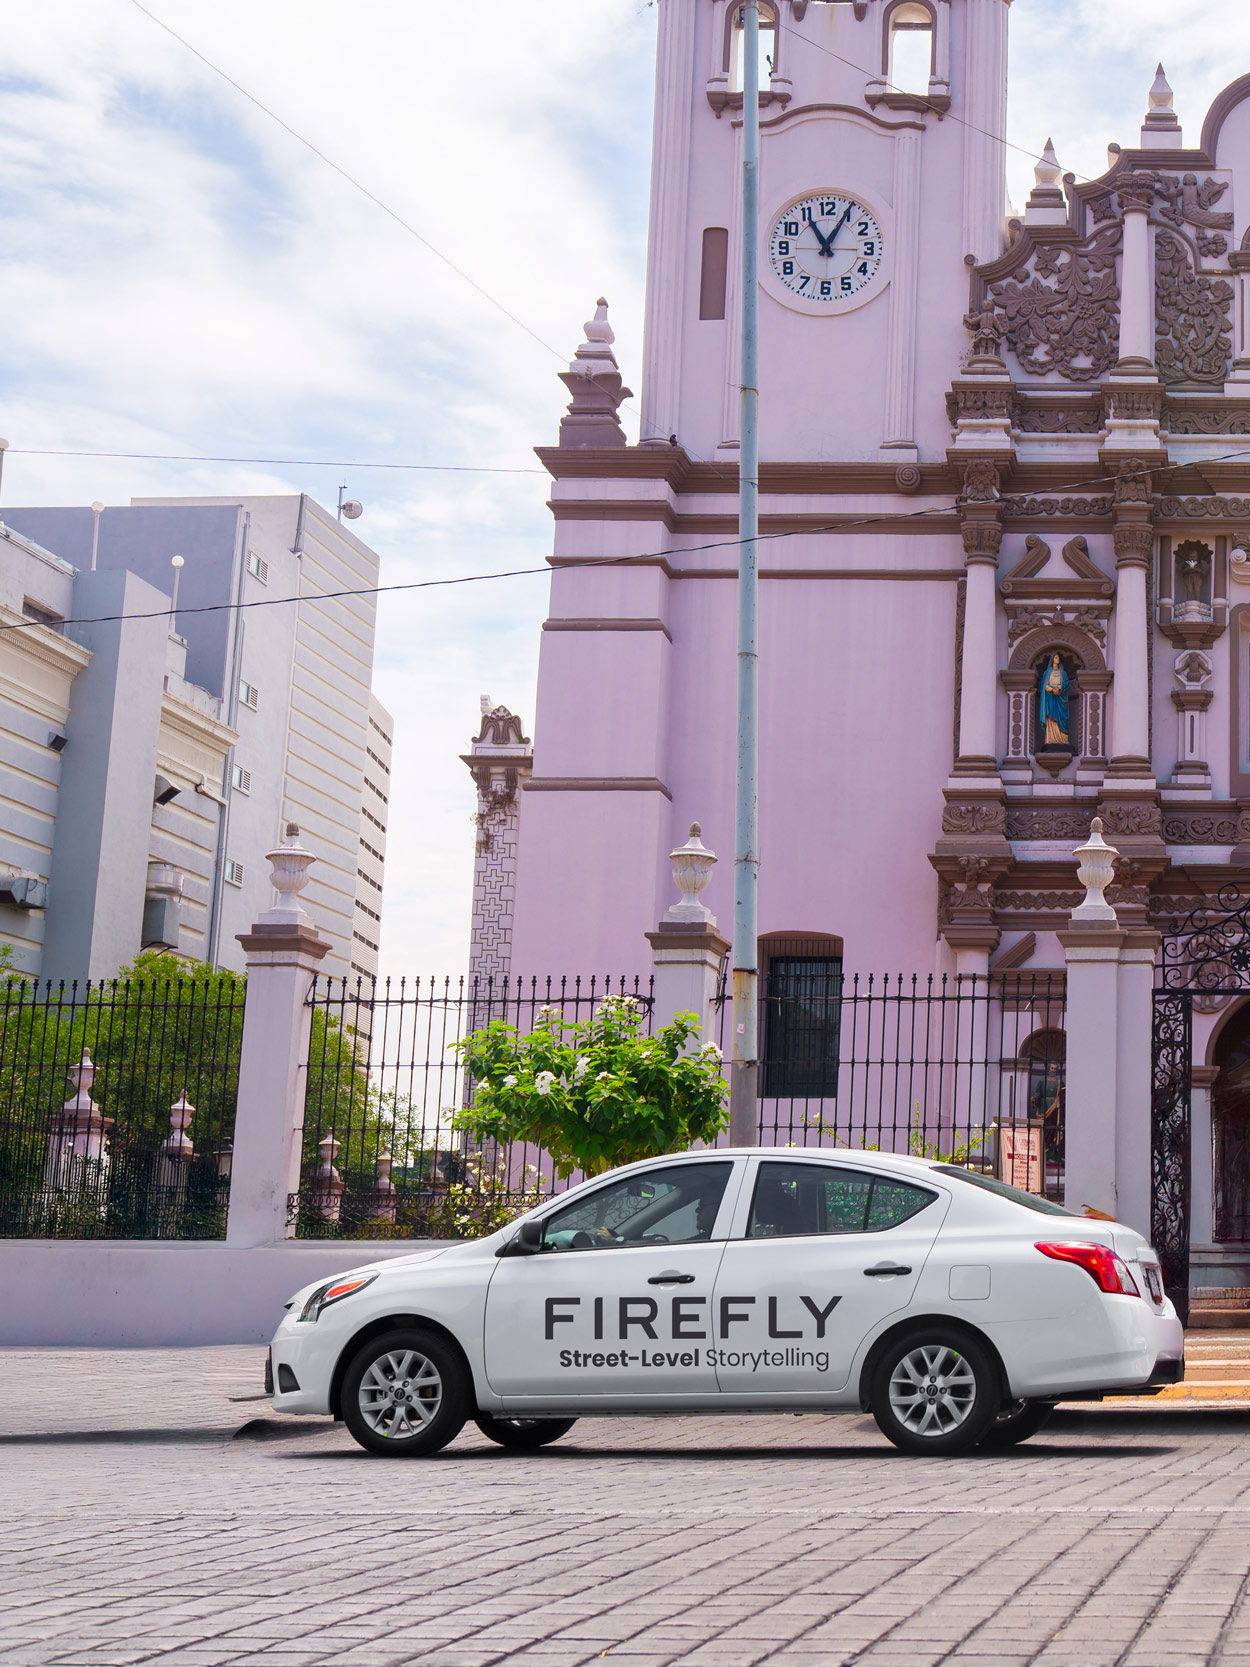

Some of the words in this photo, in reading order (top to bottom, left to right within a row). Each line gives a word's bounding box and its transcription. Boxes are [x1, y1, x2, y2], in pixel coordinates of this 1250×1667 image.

[801, 206, 812, 222] 11
[819, 201, 836, 216] 12
[784, 221, 799, 236] 10
[857, 221, 868, 236] 2
[778, 240, 789, 255] 9
[863, 241, 874, 256] 3
[782, 261, 793, 275] 8
[857, 261, 868, 276] 4
[799, 275, 810, 290] 7
[820, 280, 831, 295] 6
[840, 276, 851, 291] 5
[545, 1296, 843, 1340] FIREFLY
[559, 1348, 700, 1368] Street-Level
[706, 1347, 829, 1372] Storytelling
